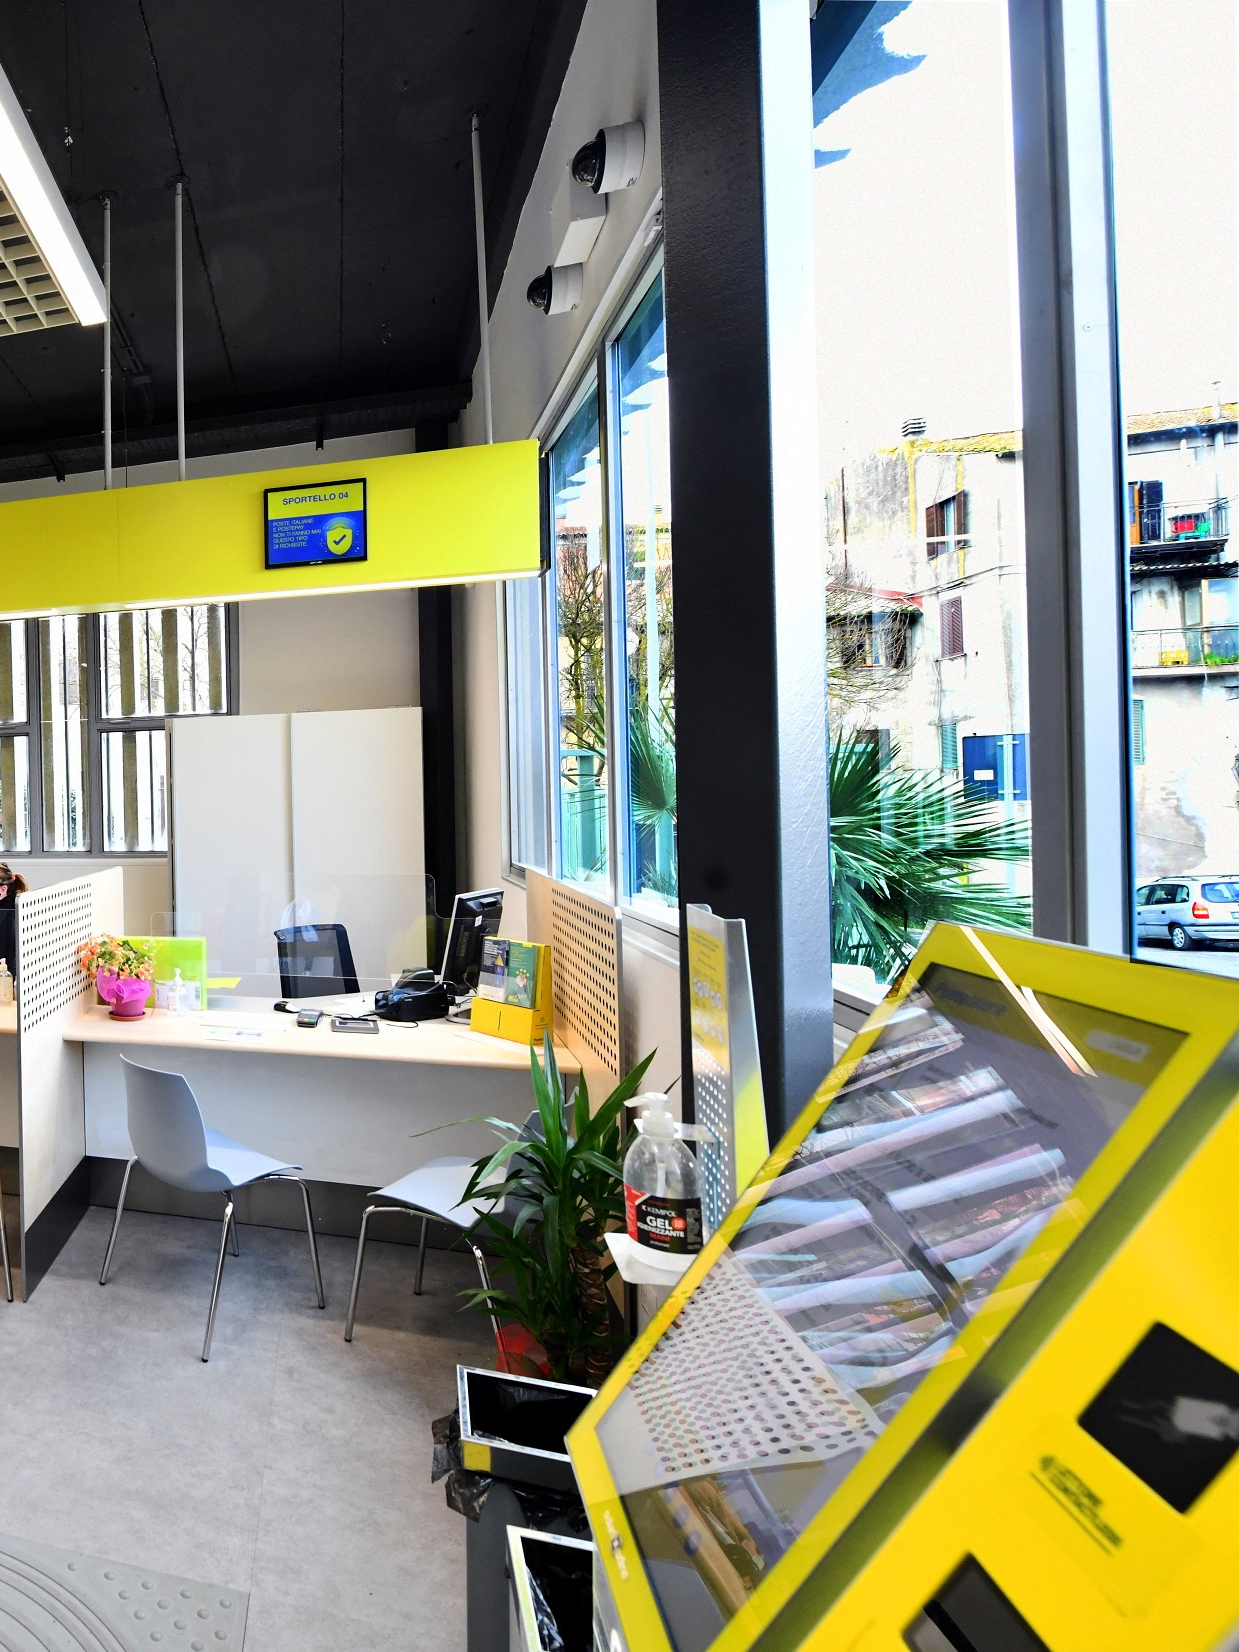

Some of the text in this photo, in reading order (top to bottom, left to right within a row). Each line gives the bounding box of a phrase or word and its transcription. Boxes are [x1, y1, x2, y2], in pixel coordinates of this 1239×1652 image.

[282, 492, 349, 506] SPORTELLO 04
[647, 1206, 677, 1217] KEMPOL
[646, 1215, 673, 1231] GEL
